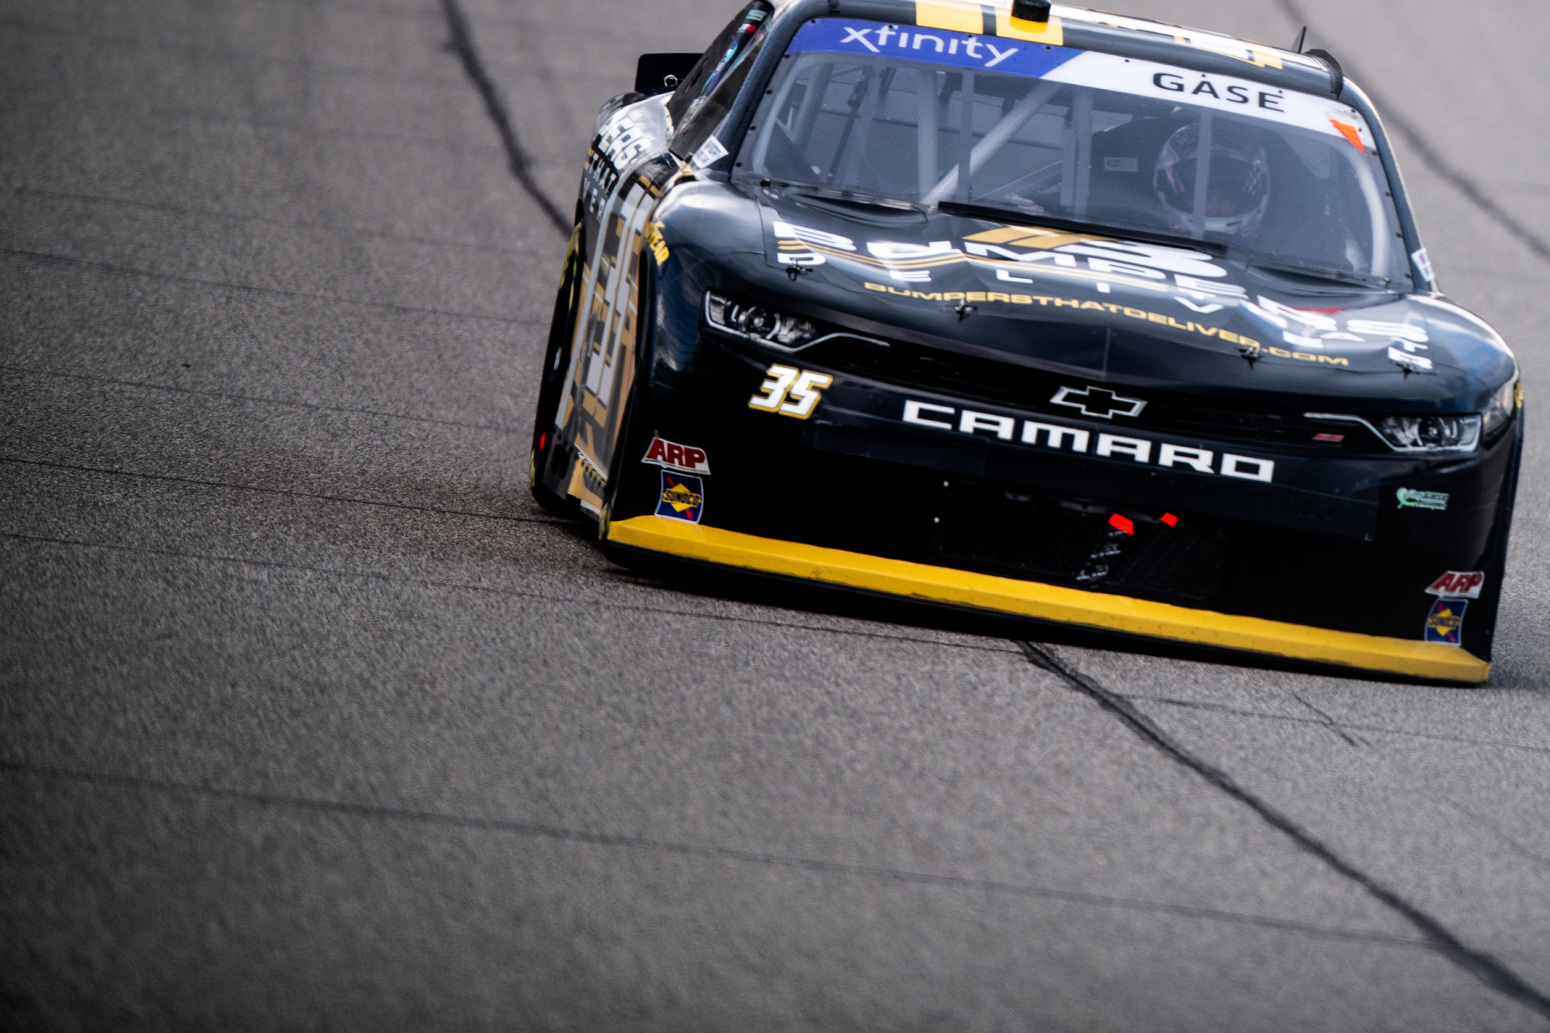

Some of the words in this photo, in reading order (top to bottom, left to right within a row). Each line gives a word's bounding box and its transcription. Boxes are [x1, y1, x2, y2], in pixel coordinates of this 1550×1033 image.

[839, 23, 1019, 68] xfinity
[1152, 72, 1285, 113] GASE
[864, 281, 1350, 367] BUMPERSTHATDELIVER.COM
[748, 363, 833, 420] 35
[645, 438, 706, 469] ARP
[902, 399, 1275, 483] CAMARO
[663, 488, 701, 508] SUNOCO
[1431, 572, 1483, 593] ARP
